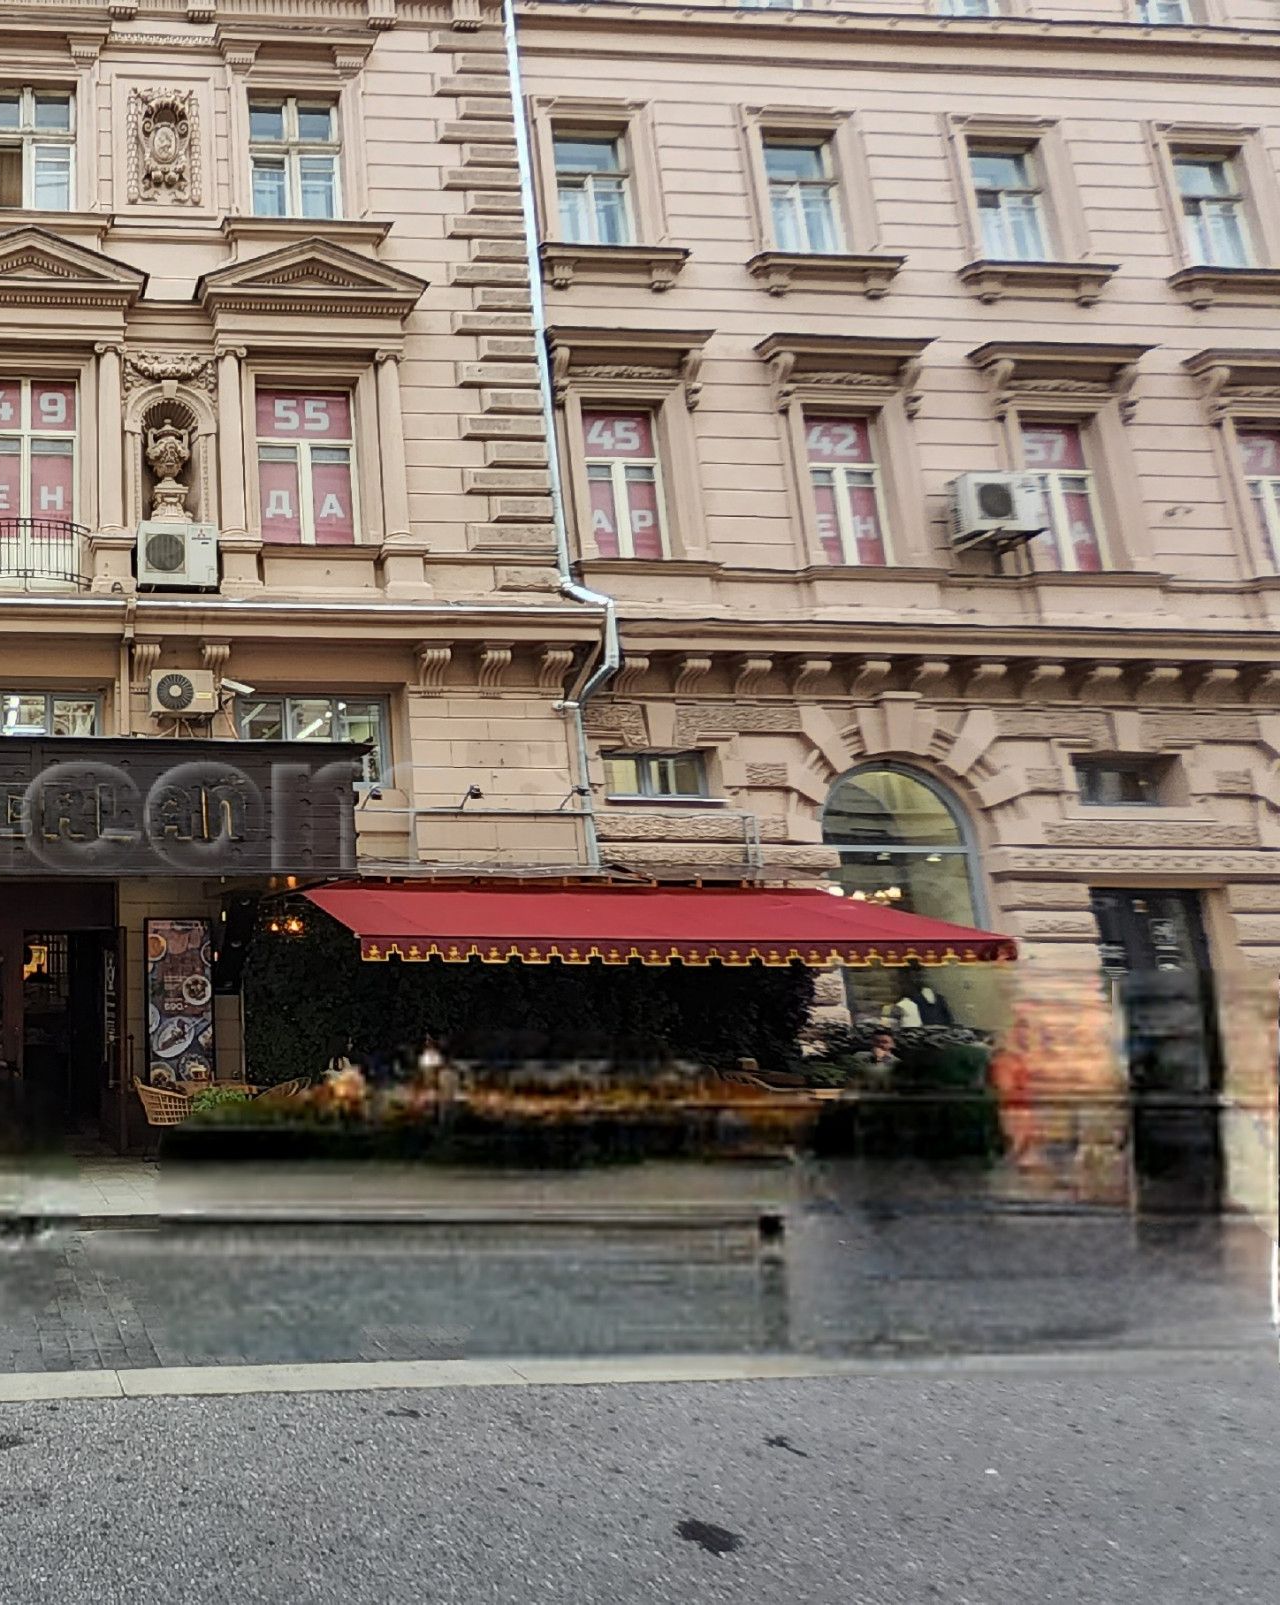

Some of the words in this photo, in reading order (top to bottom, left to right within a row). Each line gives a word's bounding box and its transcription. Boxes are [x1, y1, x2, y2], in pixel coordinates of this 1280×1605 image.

[274, 399, 330, 431] 55
[587, 420, 640, 450] 45
[808, 425, 862, 457] 42
[1022, 432, 1065, 463] 57
